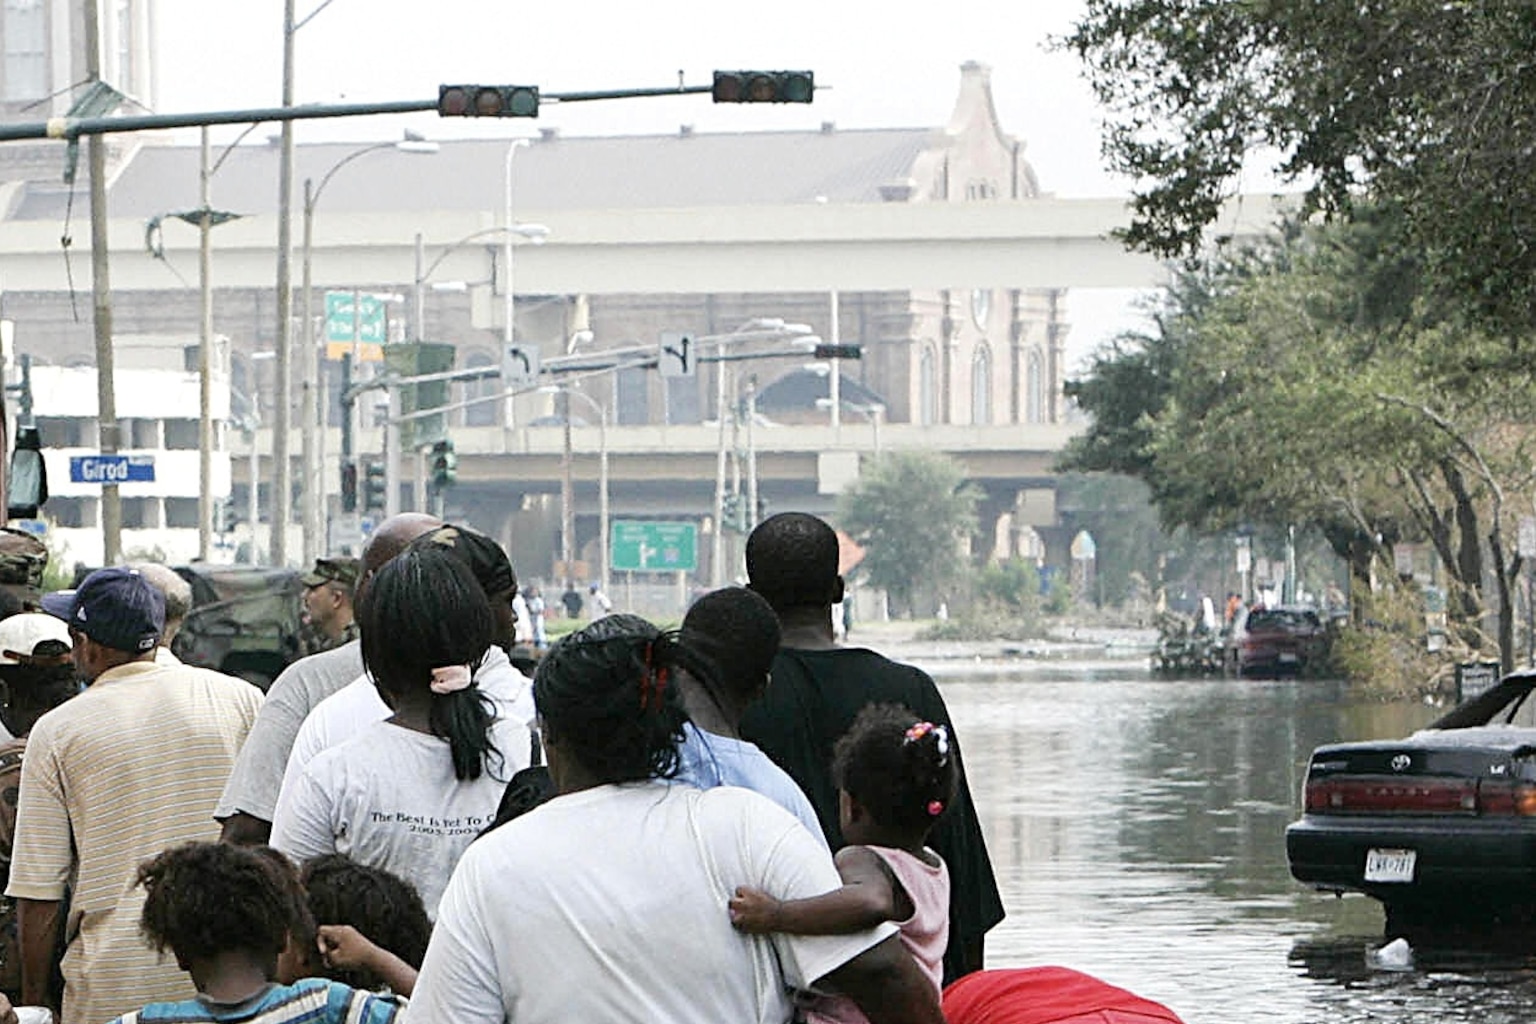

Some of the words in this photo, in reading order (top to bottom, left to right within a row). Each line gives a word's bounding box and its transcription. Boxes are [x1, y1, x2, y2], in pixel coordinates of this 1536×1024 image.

[82, 459, 128, 480] Girod
[370, 811, 392, 822] The
[396, 812, 423, 824] Best
[443, 816, 459, 828] Yet
[464, 815, 481, 827] To
